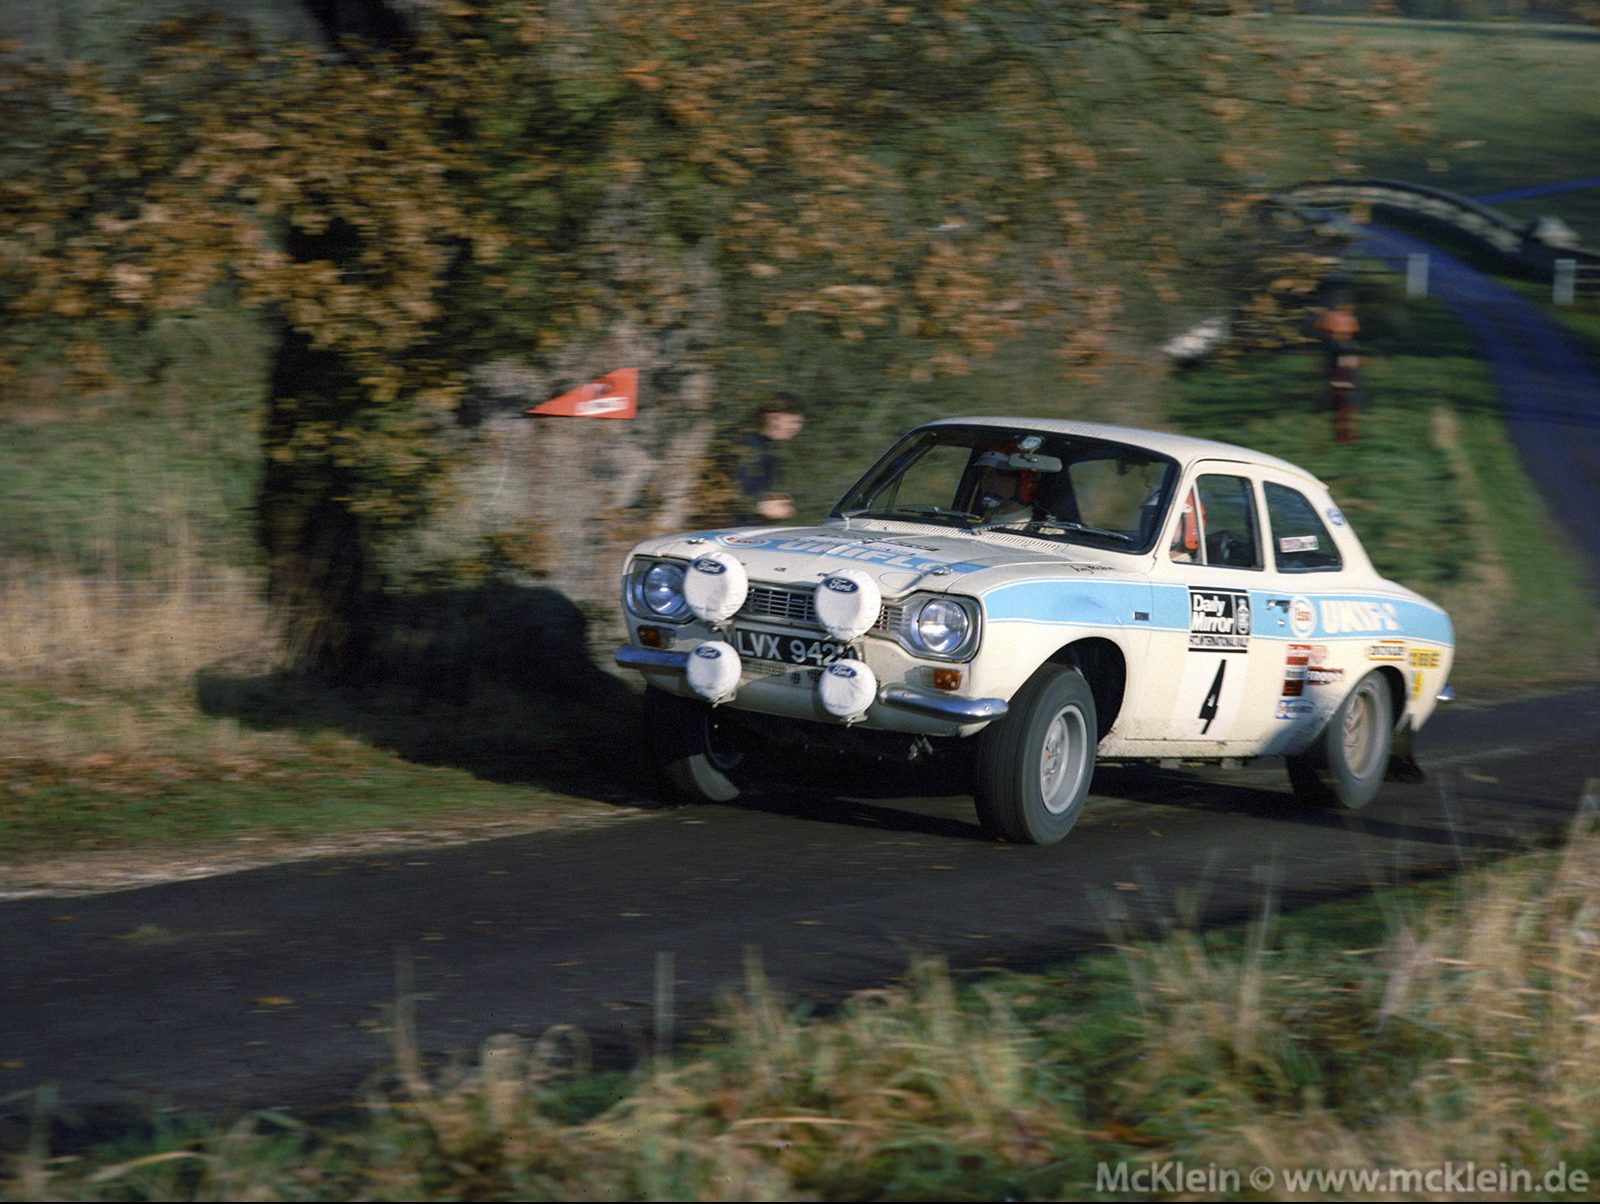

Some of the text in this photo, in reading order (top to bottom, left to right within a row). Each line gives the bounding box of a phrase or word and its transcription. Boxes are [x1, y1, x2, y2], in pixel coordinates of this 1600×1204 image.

[829, 578, 853, 591] Ford
[1193, 594, 1226, 616] Daily
[1192, 612, 1234, 632] Mirror
[737, 631, 782, 660] LVX
[832, 664, 853, 677] Ford
[1198, 659, 1226, 734] 4
